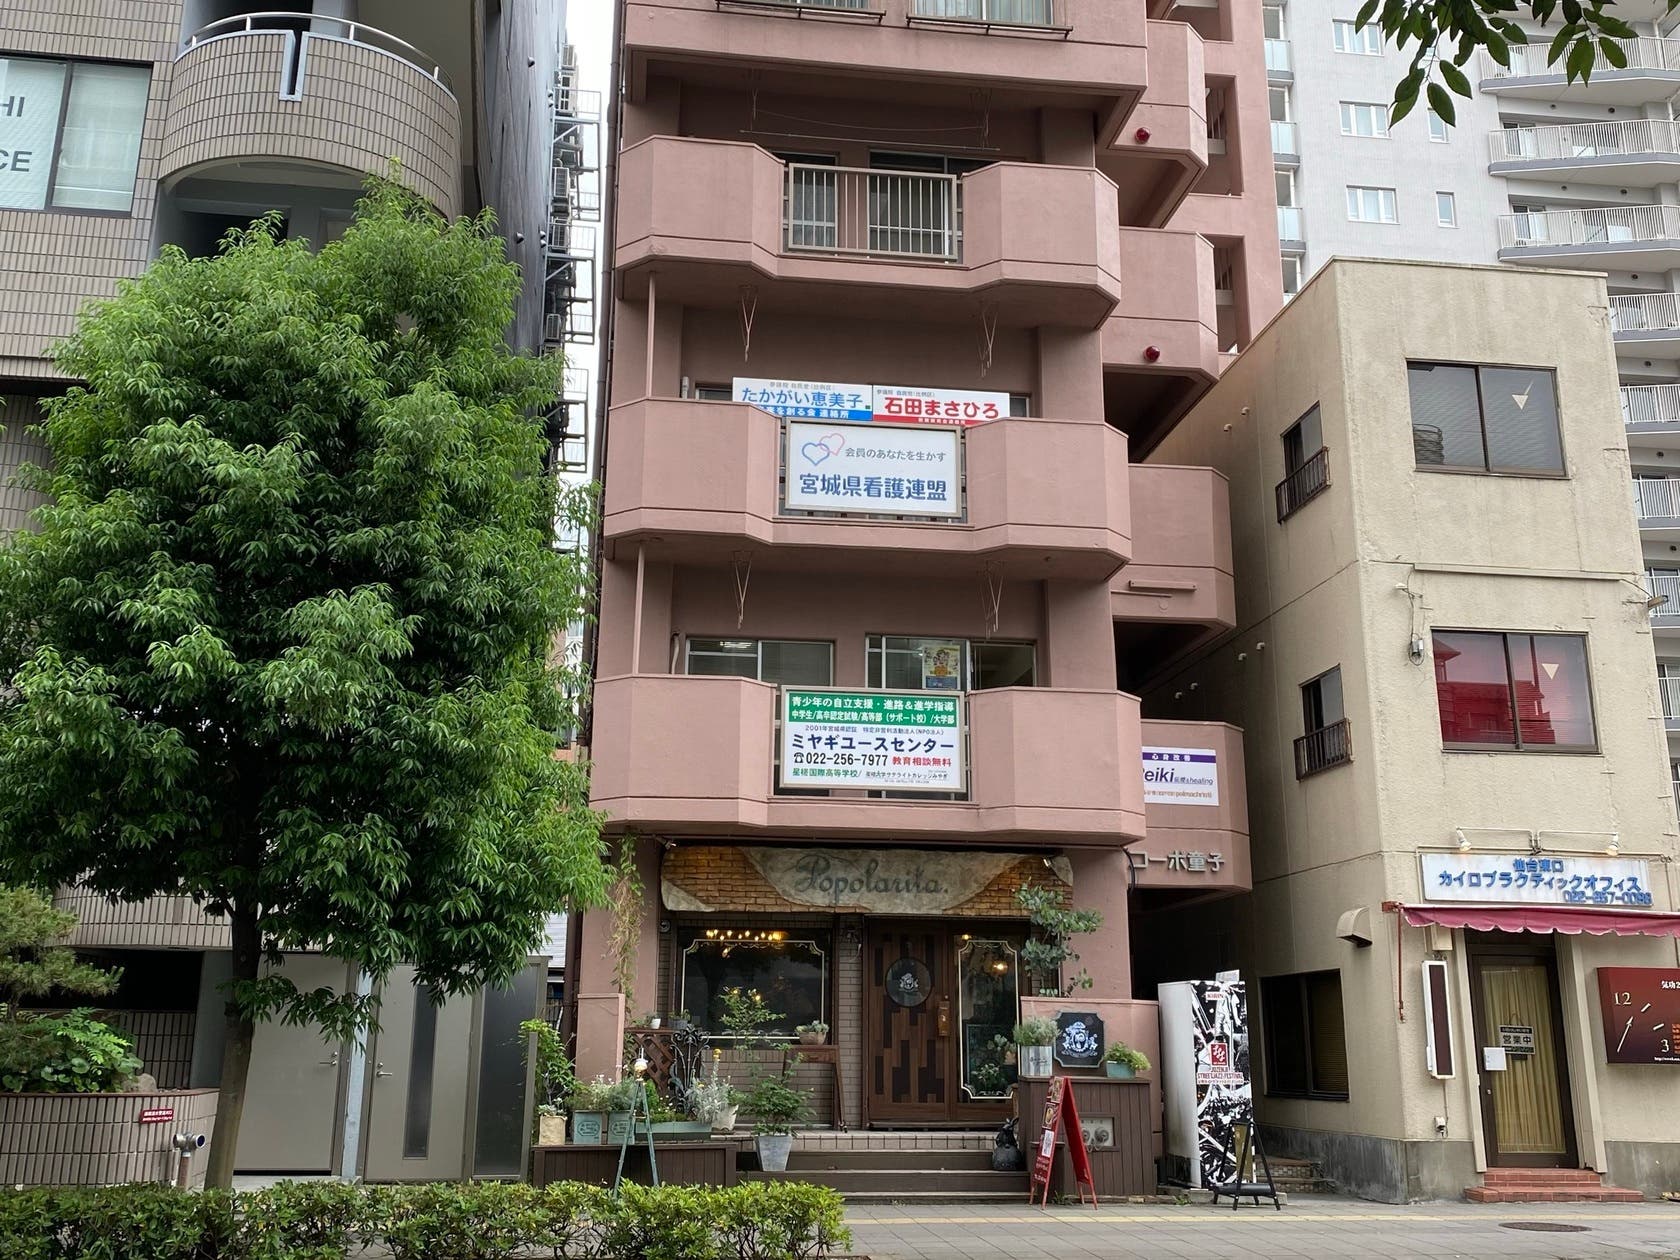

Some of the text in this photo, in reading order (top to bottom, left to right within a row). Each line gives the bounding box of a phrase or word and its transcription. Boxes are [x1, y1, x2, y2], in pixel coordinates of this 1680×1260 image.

[742, 387, 863, 409] たかがい恵美子
[884, 397, 999, 419] 石田まさひろ
[845, 447, 947, 463] 会員のあなたを生かす
[799, 472, 948, 502] 宮城県看護連盟
[792, 733, 954, 753] ミヤギユースセンター
[806, 752, 952, 767] 022-256-7977 教育相談無料
[1143, 767, 1175, 783] eiki
[1513, 858, 1564, 873] 仙台東口
[1439, 869, 1642, 892] カイロプラクティックオフィス
[1614, 991, 1632, 1005] 12
[1502, 1035, 1531, 1044] 営業中
[1660, 1039, 1669, 1053] 3
